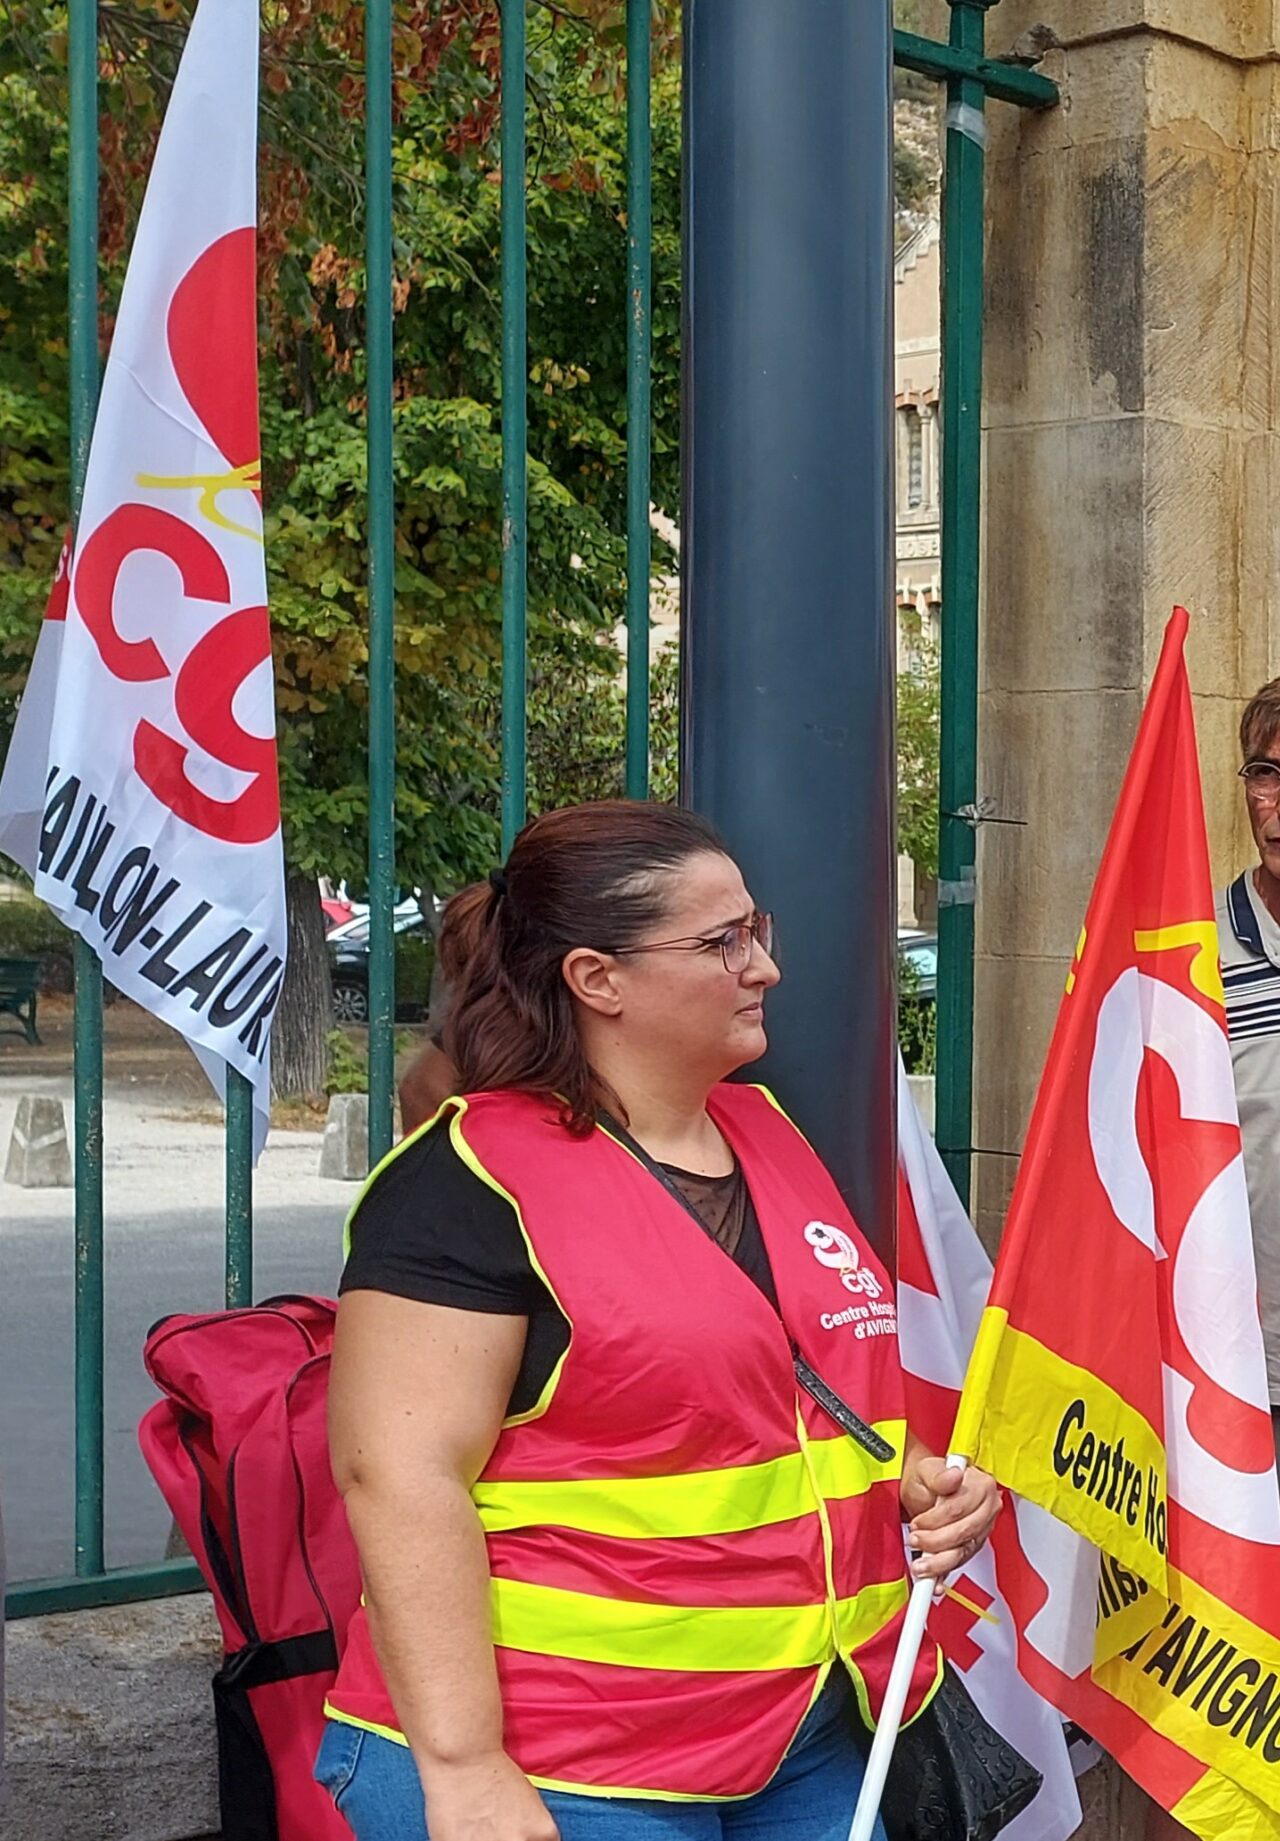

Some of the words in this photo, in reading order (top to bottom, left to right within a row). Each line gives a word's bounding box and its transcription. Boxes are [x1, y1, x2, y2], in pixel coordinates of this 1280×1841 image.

[841, 1267, 883, 1298] cgt
[820, 1306, 869, 1330] Centre
[1053, 1399, 1142, 1526] Centre
[1145, 1465, 1167, 1555] Ho
